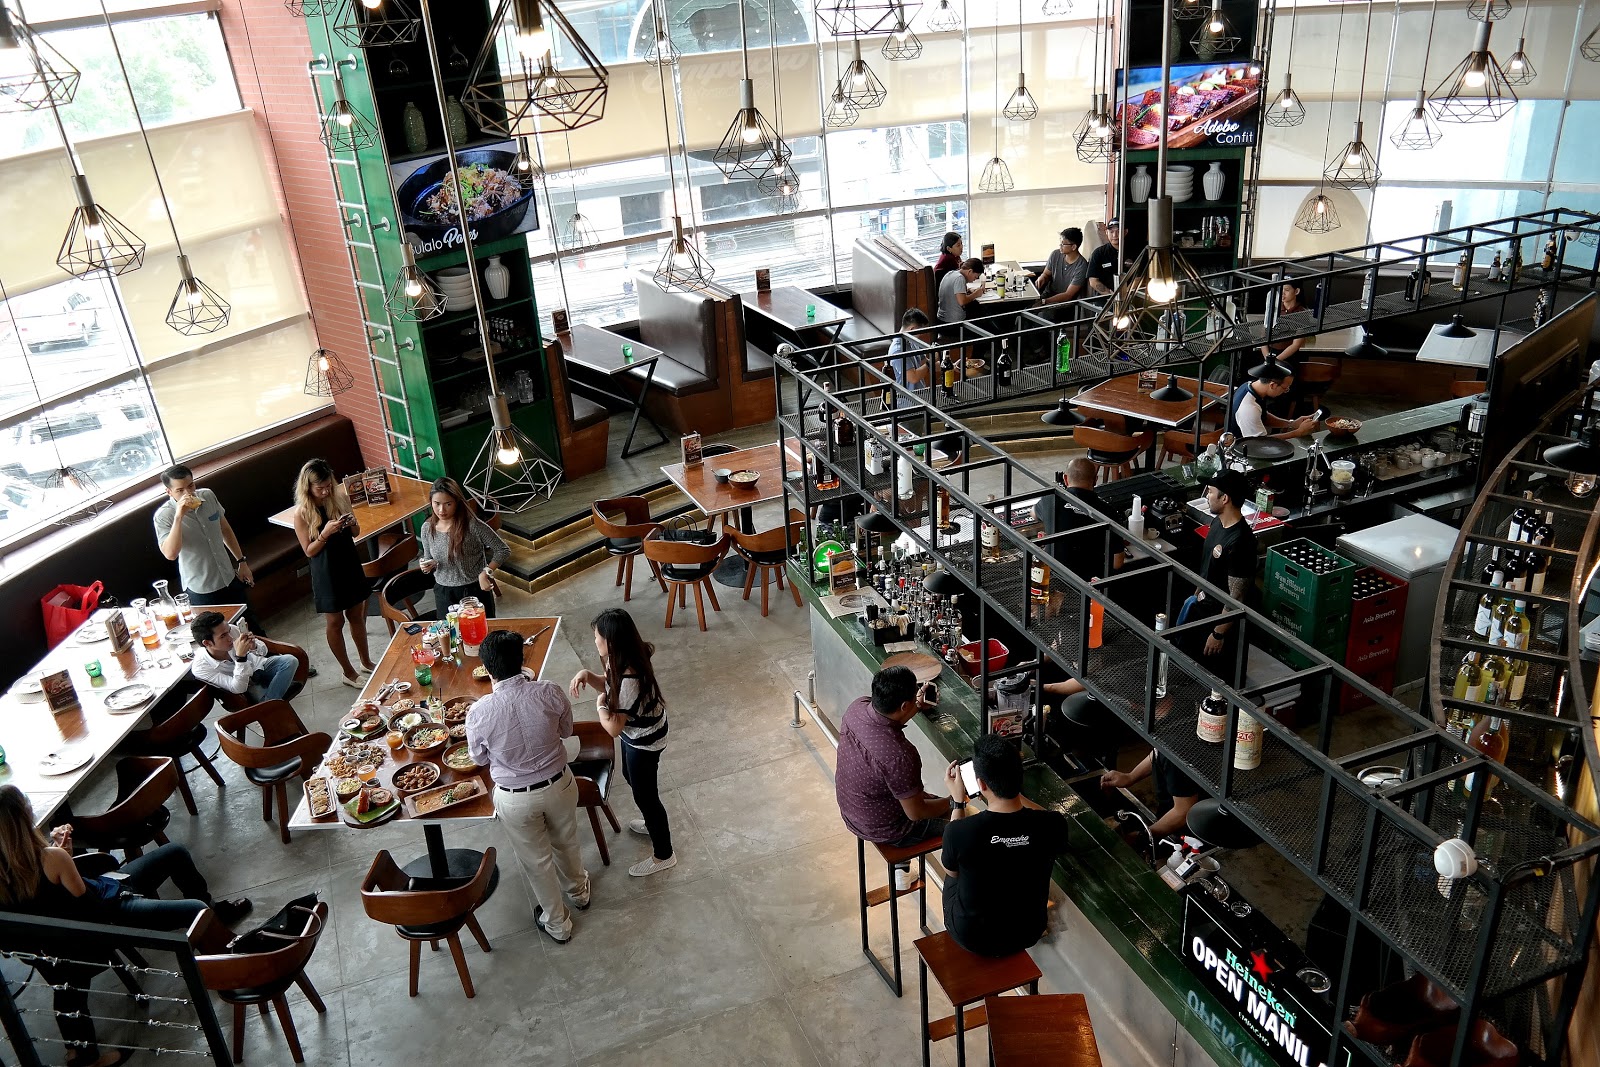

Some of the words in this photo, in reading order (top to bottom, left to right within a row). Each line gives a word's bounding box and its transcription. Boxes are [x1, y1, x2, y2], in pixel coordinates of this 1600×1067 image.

[1193, 119, 1239, 136] Adobo
[1216, 131, 1253, 144] Confit
[443, 227, 478, 248] Paes
[1375, 608, 1397, 620] Brewery
[1225, 947, 1298, 1030] Heineken
[1192, 936, 1244, 1002] OPEN
[1246, 990, 1329, 1067] MANIL
